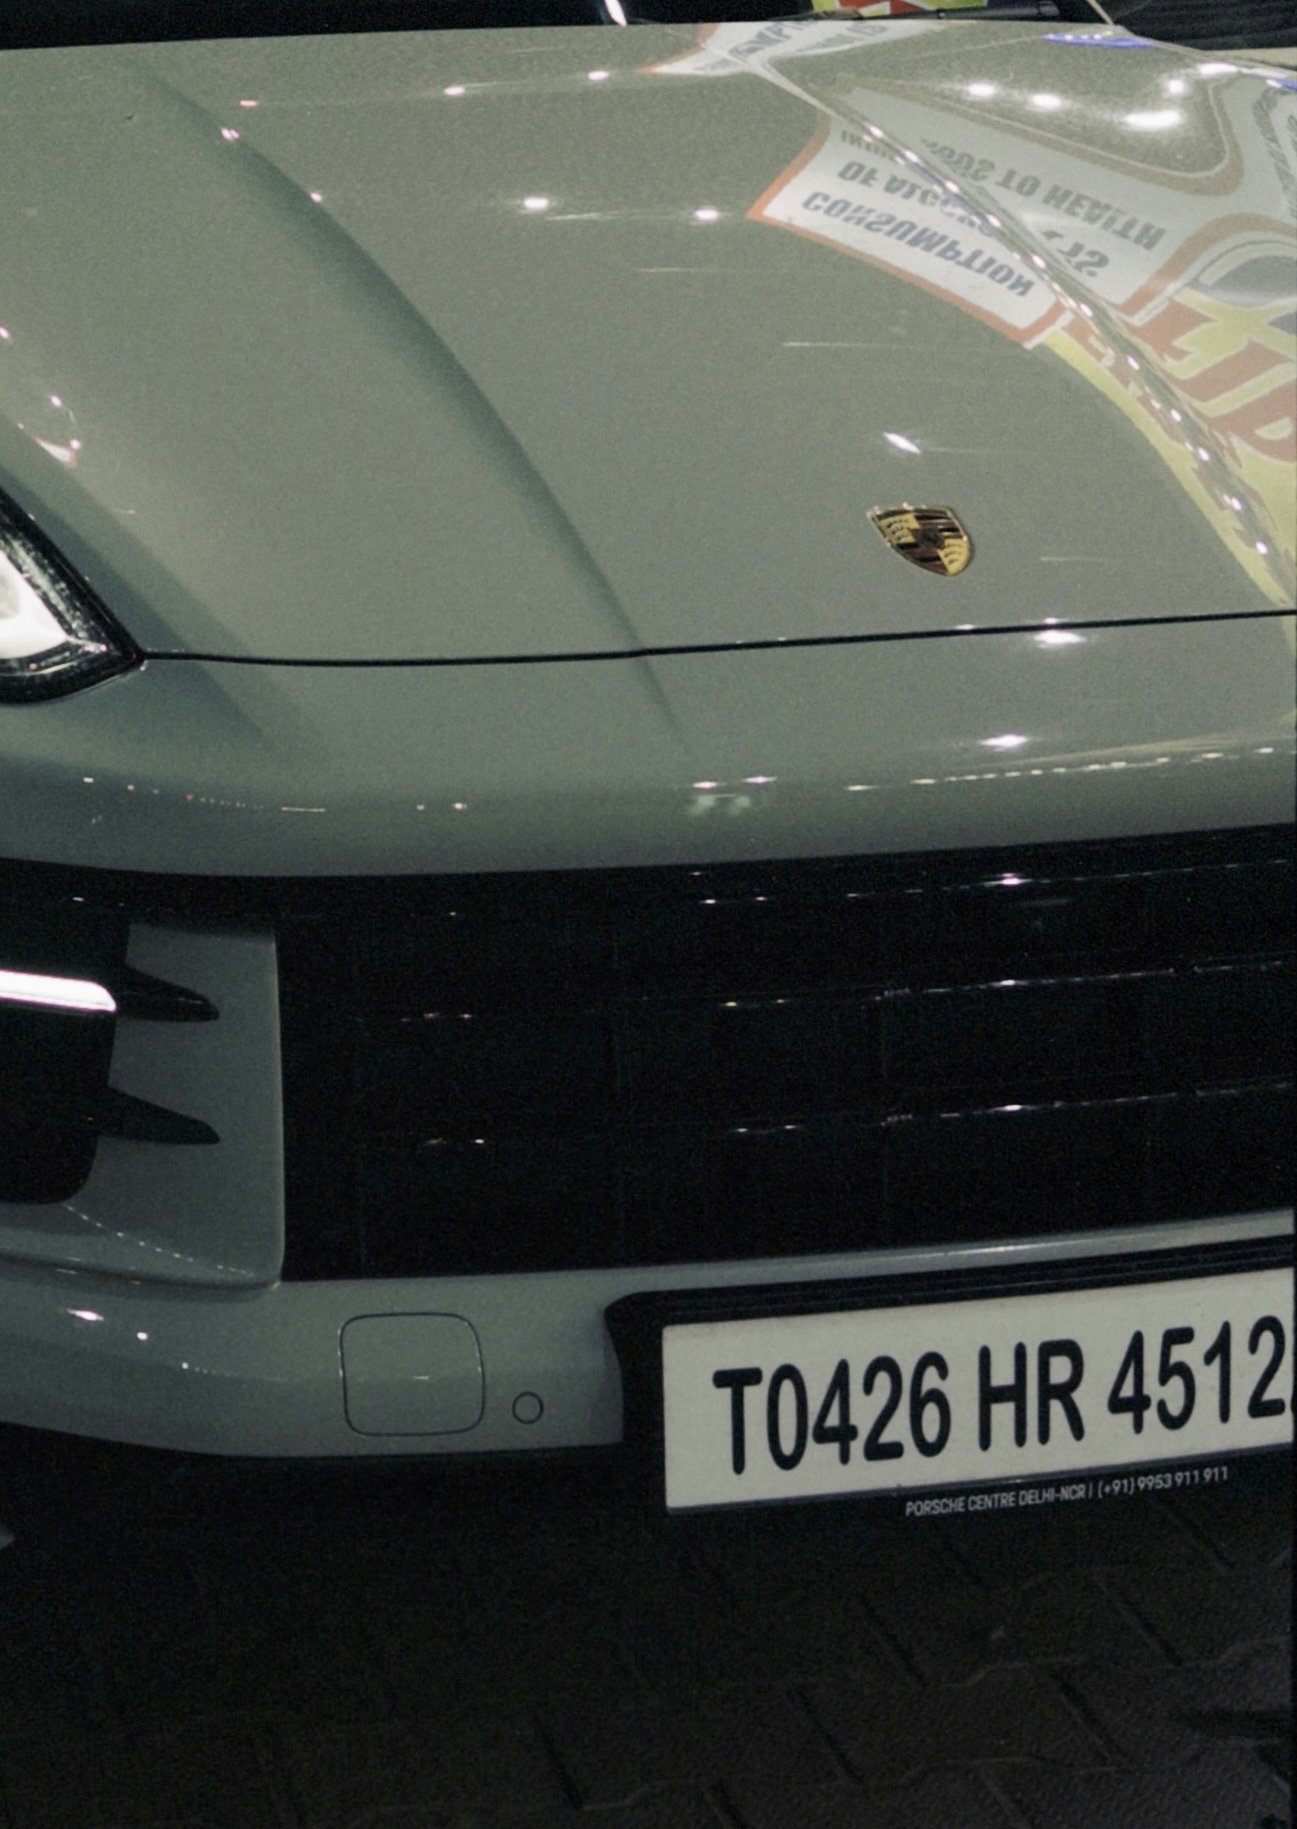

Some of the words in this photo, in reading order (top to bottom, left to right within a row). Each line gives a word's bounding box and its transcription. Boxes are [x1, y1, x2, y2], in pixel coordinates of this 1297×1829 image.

[712, 1352, 952, 1475] T0426
[978, 1339, 1085, 1452] HR
[1107, 1315, 1286, 1434] 4512
[906, 1496, 965, 1516] PORSCHE
[968, 1491, 1016, 1511] CENTRE
[1019, 1482, 1086, 1506] DELHI-NCR
[1098, 1476, 1134, 1499] (+91)
[1137, 1473, 1173, 1491] 9953
[1175, 1469, 1199, 1486] 911
[1204, 1466, 1228, 1483] 911
